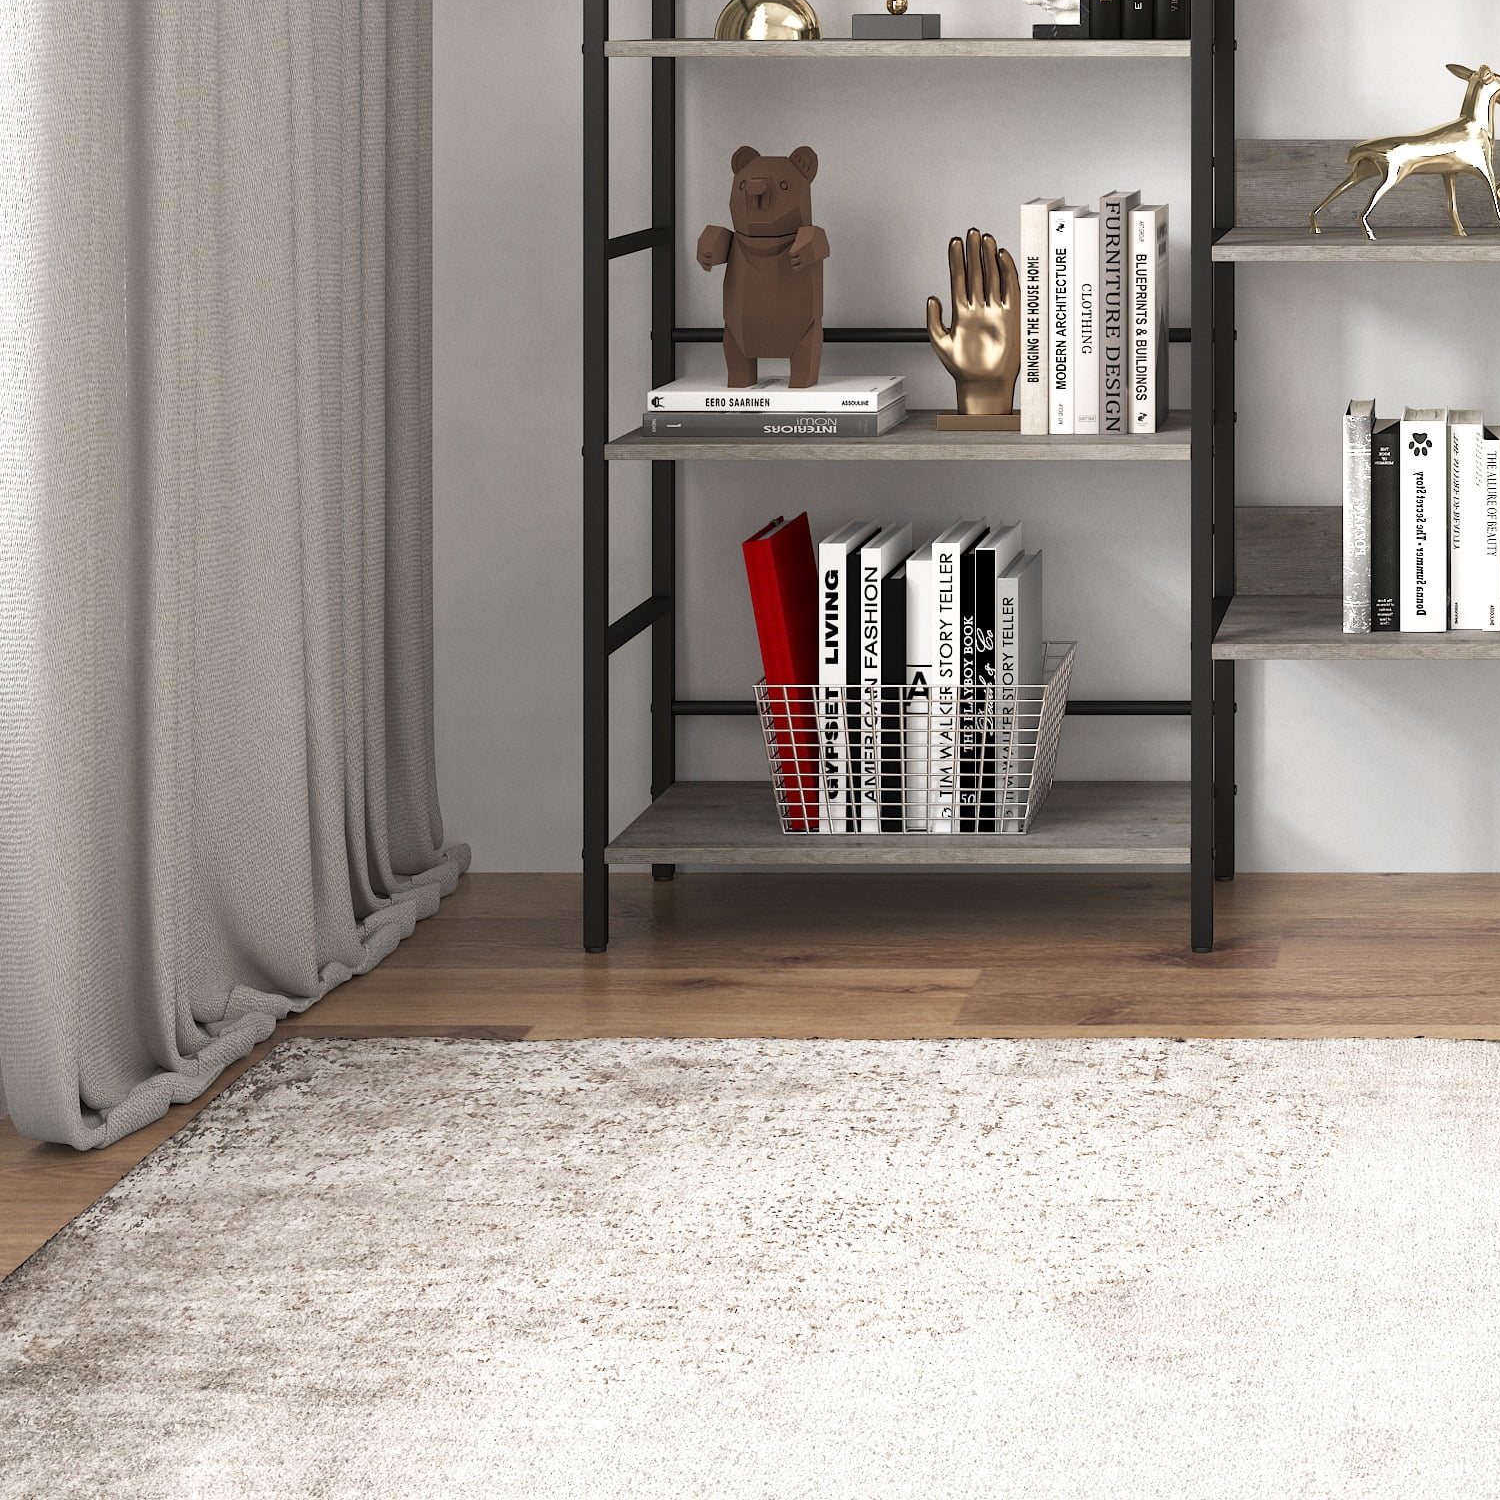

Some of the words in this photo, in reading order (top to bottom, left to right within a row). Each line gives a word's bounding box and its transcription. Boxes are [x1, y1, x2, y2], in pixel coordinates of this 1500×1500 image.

[1027, 256, 1040, 282] HOME
[1055, 248, 1067, 337] ARCHITECTURE
[1105, 202, 1121, 338] FURNITURE
[1135, 254, 1148, 325] BLUEPRINTS
[1027, 284, 1040, 315] HOUSE
[1081, 283, 1093, 355] CLOTHING
[1027, 317, 1040, 336] THE
[1135, 328, 1148, 336] &
[1027, 338, 1040, 383] BRINGING
[1055, 340, 1067, 390] MODERN
[1135, 339, 1148, 401] BUILDINGS
[705, 397, 726, 408] EERO
[728, 397, 770, 408] SAARINEN
[1105, 346, 1121, 432] DESIGN
[763, 425, 837, 434] INTERIORS
[1486, 521, 1497, 557] BEAUTY
[939, 553, 953, 613] TELLER
[824, 569, 839, 665] LIVING
[864, 567, 878, 669] FASHION
[963, 615, 974, 655] BOOK
[975, 627, 994, 653] Co
[1003, 597, 1014, 647] TELLER
[939, 619, 953, 678] STORY
[963, 658, 974, 722] PLAYBOY
[1003, 652, 1014, 700] STORY
[825, 686, 839, 799] GYPSET
[864, 678, 878, 802] AMERICAN
[939, 685, 953, 759] WALKER
[963, 725, 974, 753] THE
[939, 766, 953, 798] TIM
